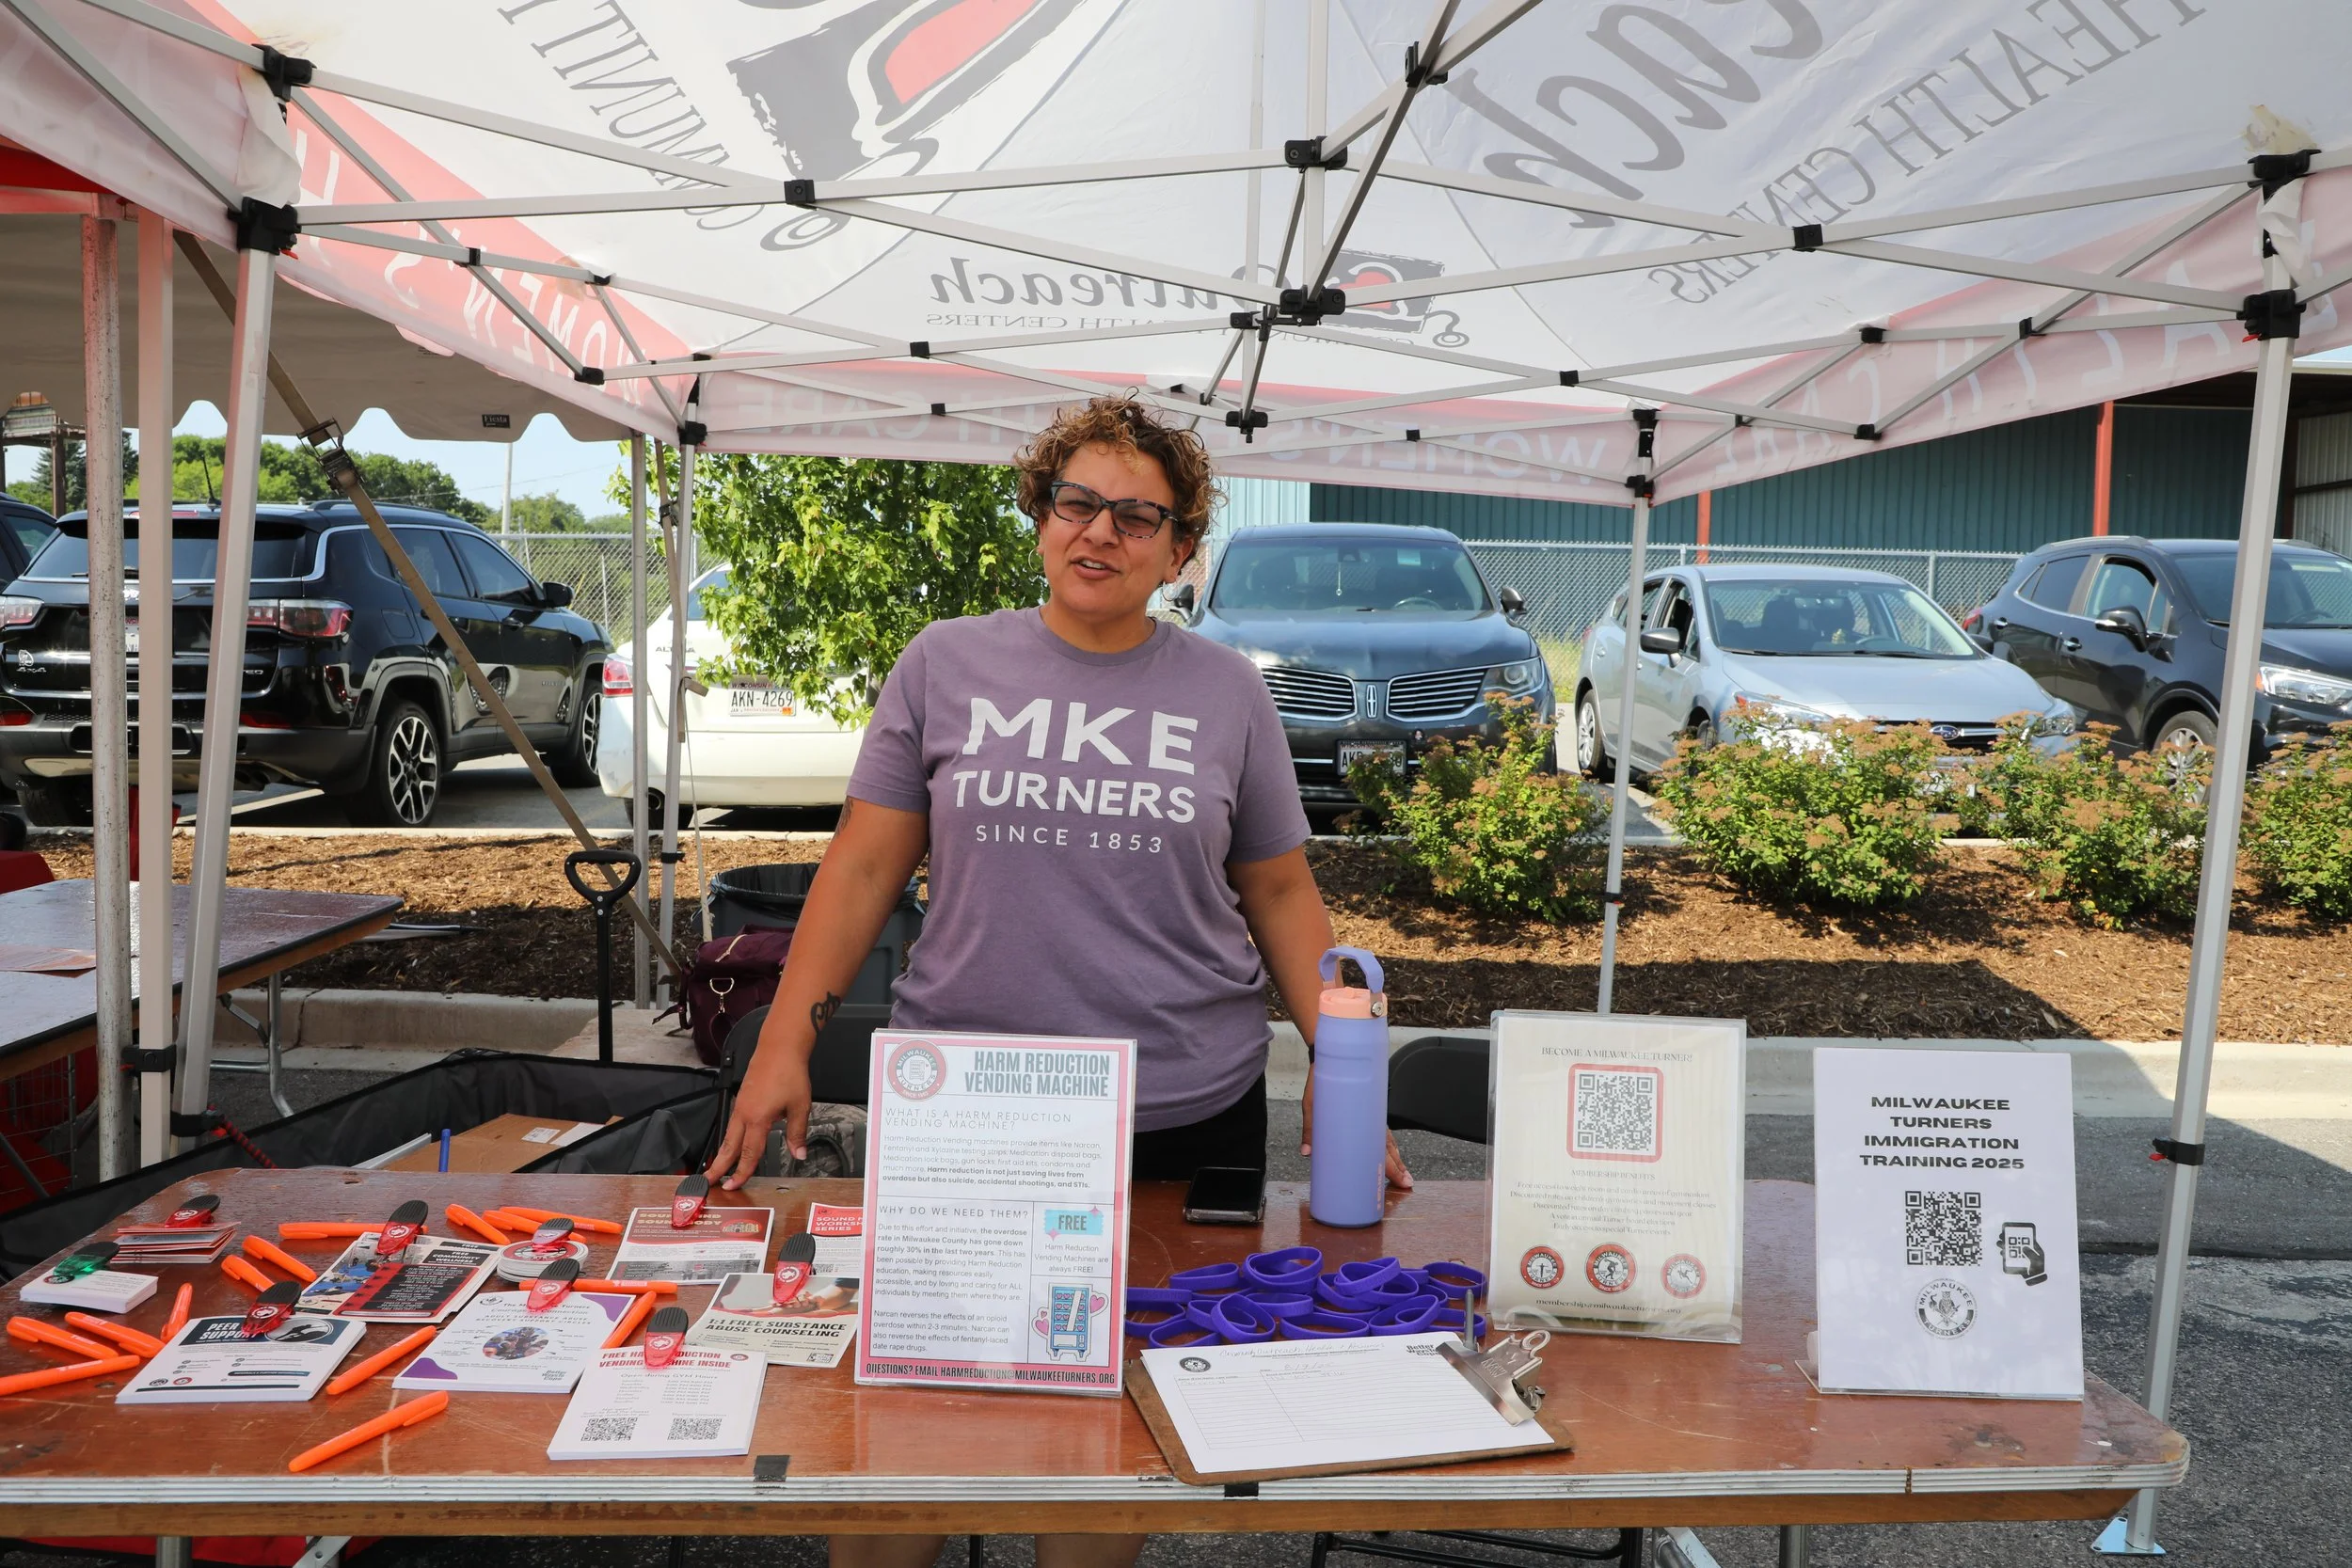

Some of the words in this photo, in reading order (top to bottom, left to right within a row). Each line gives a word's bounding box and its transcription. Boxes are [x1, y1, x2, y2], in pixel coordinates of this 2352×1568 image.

[731, 690, 793, 707] AKN-4269
[961, 697, 1199, 776] MKE
[952, 770, 1197, 824] TURNERS
[976, 824, 1070, 847] SINCE
[1089, 832, 1162, 854] 1853
[896, 1047, 938, 1070] MILWAUKEE
[1541, 1046, 1582, 1057] BECOME
[1583, 1049, 1592, 1057] A
[1593, 1049, 1650, 1061] MILWAUKEE
[973, 1050, 1020, 1072] HARM
[1024, 1052, 1110, 1076] REDUCTION
[897, 1071, 937, 1093] TURNERS
[963, 1070, 1032, 1095] VENDING
[1036, 1073, 1108, 1097] MACHINE
[1870, 1096, 2010, 1111] MILWAUKEE
[886, 1107, 919, 1117] WHAT
[926, 1109, 938, 1117] IS
[943, 1109, 949, 1118] A
[956, 1110, 991, 1119] HARM
[996, 1111, 1071, 1122] REDUCTION
[884, 1117, 942, 1128] VENDING
[948, 1119, 1014, 1130] MACHINE?
[1889, 1116, 1993, 1130] TURNERS
[1864, 1135, 2020, 1149] IMMIGRATION
[1859, 1154, 1968, 1168] TRAINING
[1971, 1157, 2026, 1170] 2025
[1006, 1168, 1020, 1178] just
[1021, 1168, 1046, 1178] saving
[916, 1174, 930, 1182] but
[947, 1176, 977, 1185] suicide,
[977, 1177, 1017, 1185] accidental
[1017, 1179, 1057, 1189] shootings,
[879, 1205, 903, 1214] WHY
[909, 1204, 926, 1215] DO
[930, 1206, 948, 1216] WE
[951, 1207, 984, 1218] NEED
[989, 1208, 1027, 1219] THEM?
[1057, 1213, 1087, 1231] FREE
[979, 1226, 993, 1234] the
[993, 1227, 1027, 1236] overdose
[877, 1233, 893, 1242] rate
[901, 1234, 940, 1243] Milwaukee
[941, 1236, 967, 1245] County
[982, 1239, 1002, 1247] gone
[1003, 1238, 1023, 1247] down
[876, 1244, 905, 1254] roughly
[905, 1245, 922, 1255] 30%
[922, 1245, 930, 1254] in
[930, 1246, 943, 1256] the
[944, 1246, 958, 1256] last
[972, 1249, 995, 1258] years.
[1044, 1243, 1063, 1251] Harm
[1064, 1243, 1099, 1253] Reduction
[1033, 1253, 1063, 1262] Vending
[1063, 1254, 1096, 1262] Machines
[1527, 1253, 1557, 1269] MILWAUKEE
[1594, 1250, 1628, 1268] MILWAUKEE
[1048, 1264, 1072, 1274] always
[1073, 1264, 1093, 1274] FREE!
[1919, 1282, 1973, 1307] MILWAUKEE
[206, 1323, 240, 1331] PEER
[706, 1324, 752, 1333] ABUSE
[754, 1327, 840, 1338] COUNSELING
[766, 1321, 847, 1331] SUBSTANCE
[1924, 1319, 1971, 1336] TURNERS
[866, 1362, 914, 1375] QUESTIONS?
[914, 1365, 938, 1377] EMAIL
[940, 1366, 1115, 1384] HARMREDUCTION@MILWAUKEETURNERS.ORG
